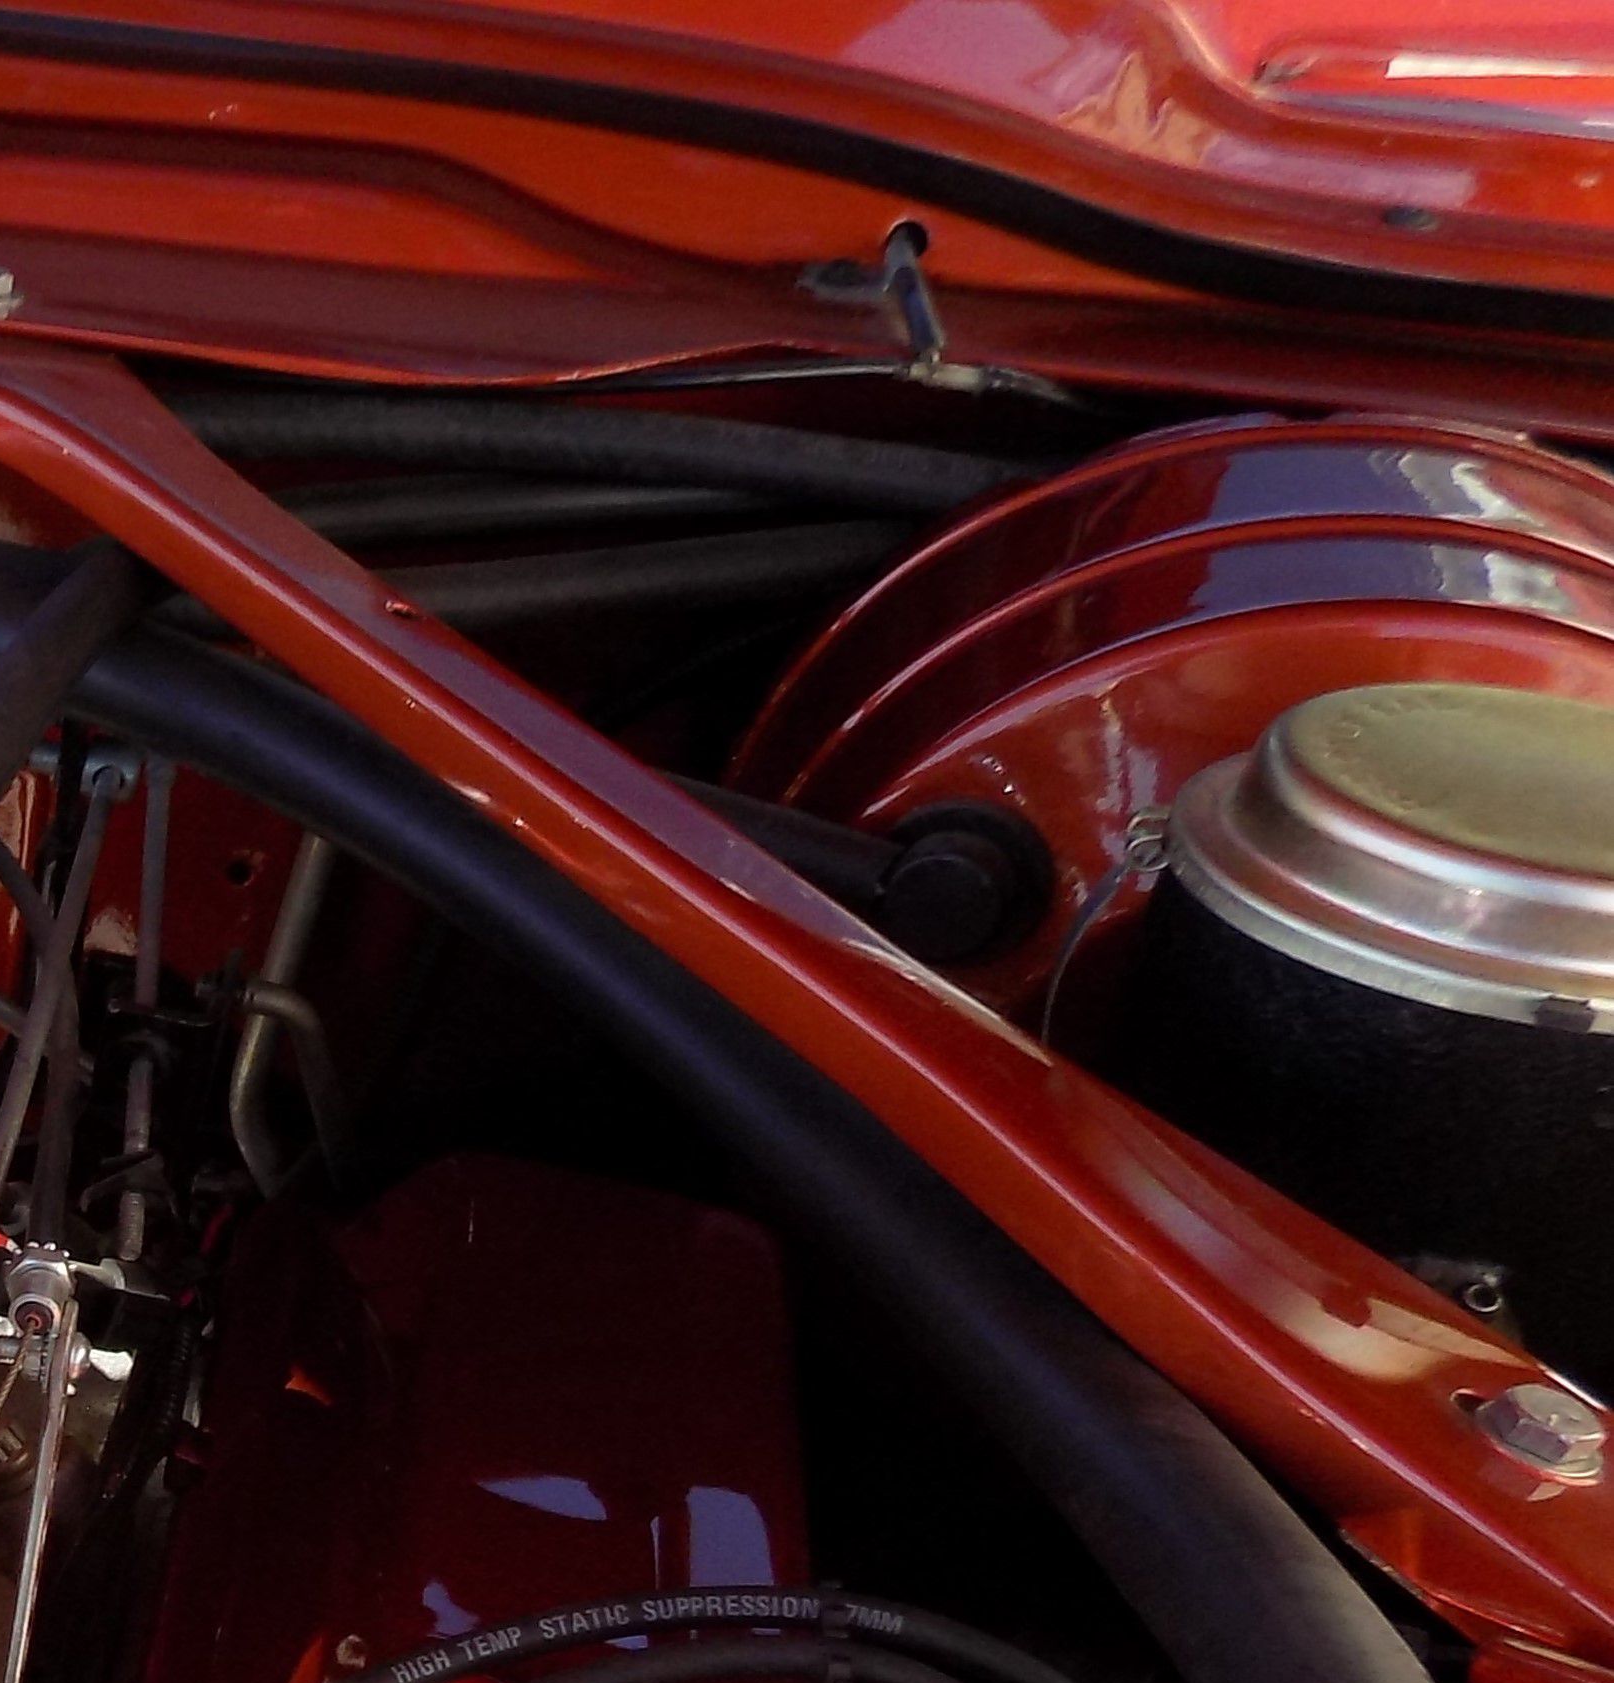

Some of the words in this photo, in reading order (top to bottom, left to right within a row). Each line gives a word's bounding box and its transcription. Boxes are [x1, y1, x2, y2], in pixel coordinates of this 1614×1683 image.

[457, 1626, 524, 1663] TEMP
[538, 1603, 632, 1641] STATIC
[640, 1593, 821, 1622] SUPPRESSION
[842, 1602, 905, 1637] 7MM
